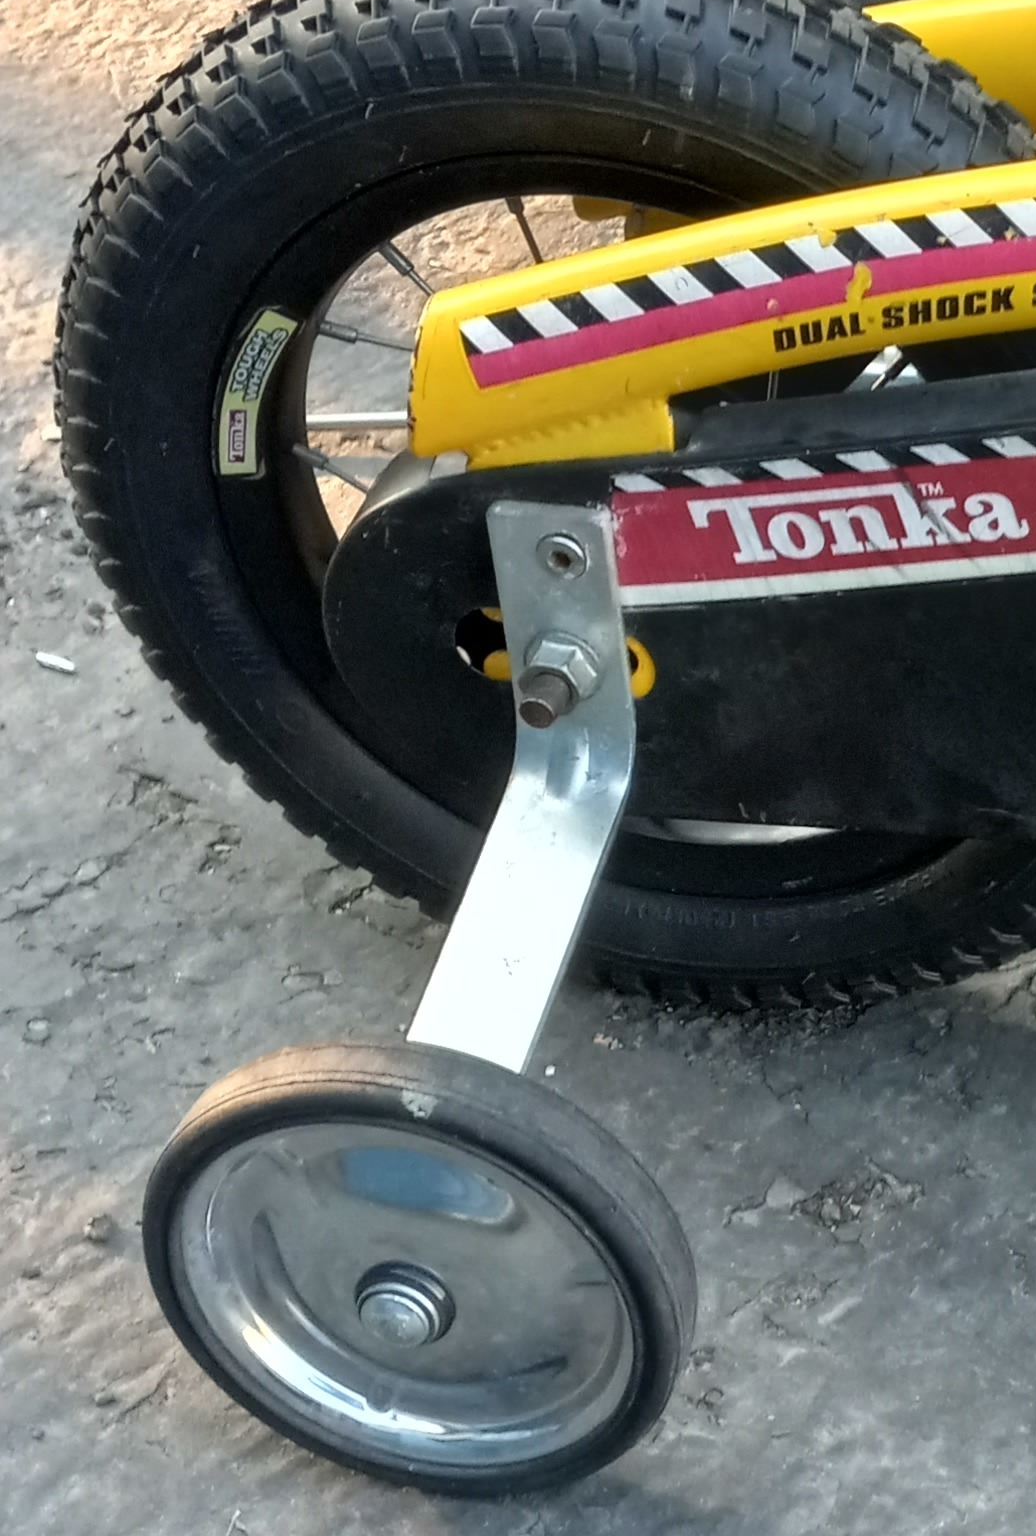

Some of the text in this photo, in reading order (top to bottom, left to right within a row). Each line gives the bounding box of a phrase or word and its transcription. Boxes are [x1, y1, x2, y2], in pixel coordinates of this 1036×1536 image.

[773, 304, 868, 353] DUAL
[881, 285, 1015, 331] SHOCK
[231, 329, 268, 392] TOUGH
[245, 329, 288, 401] WHEELS
[229, 412, 245, 462] Tonka
[687, 482, 1029, 565] Tonka
